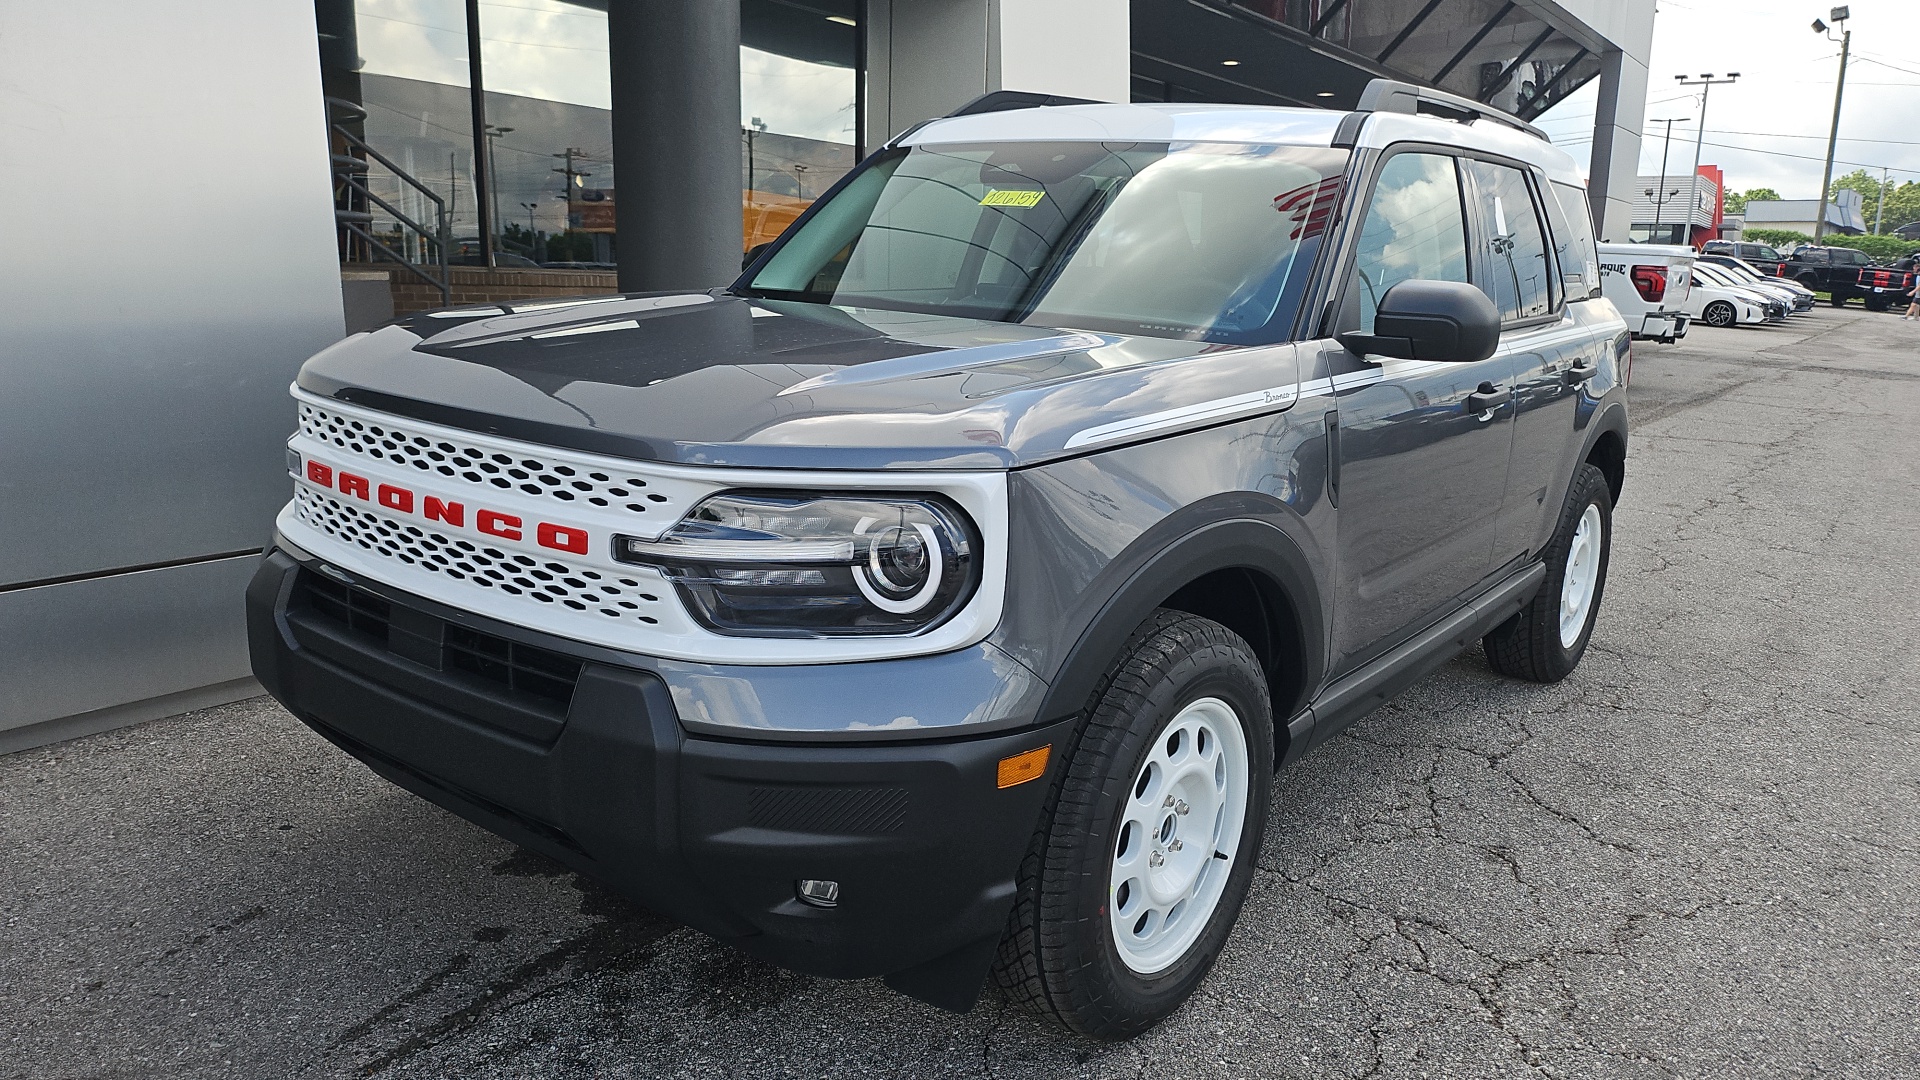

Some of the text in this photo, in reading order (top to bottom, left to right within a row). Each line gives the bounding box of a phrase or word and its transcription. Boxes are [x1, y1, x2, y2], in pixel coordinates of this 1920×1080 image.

[1600, 263, 1626, 275] RQUE
[1263, 391, 1291, 403] Bronco
[307, 459, 589, 556] BRONCO
